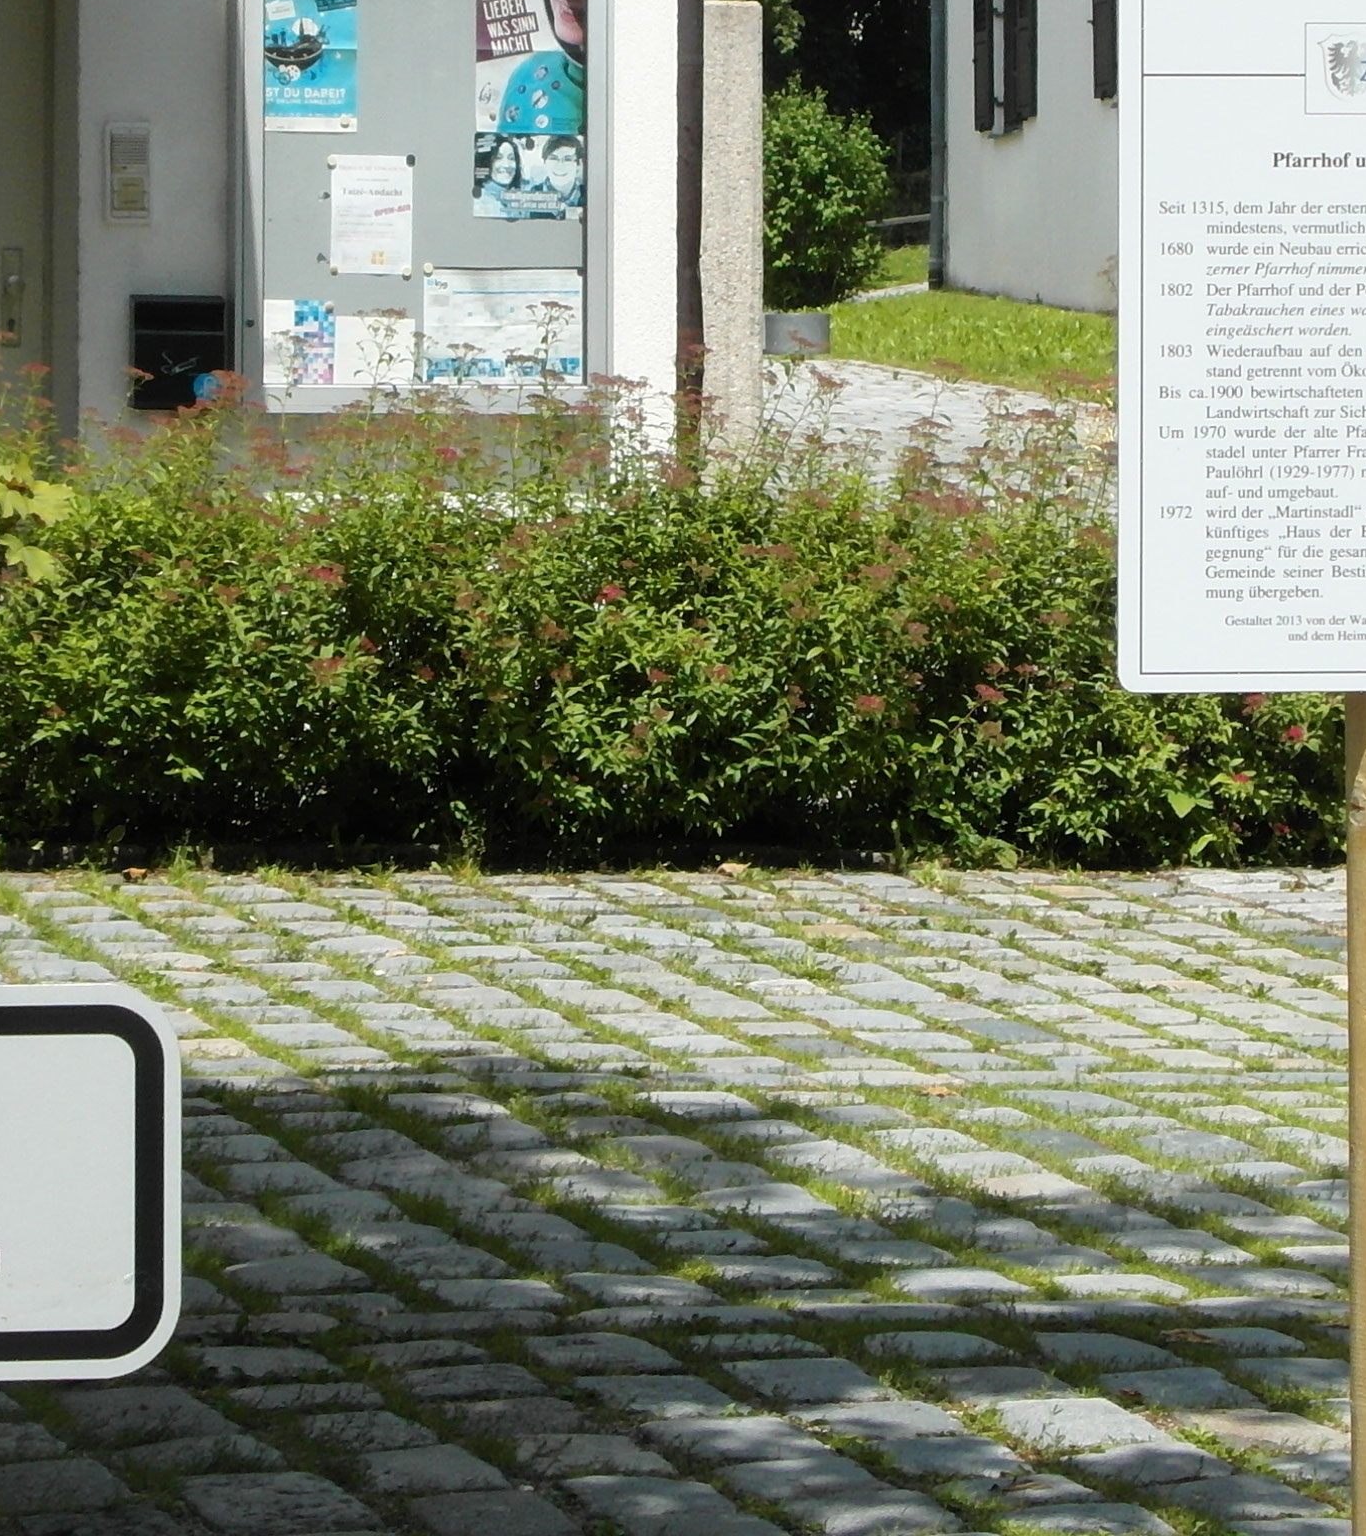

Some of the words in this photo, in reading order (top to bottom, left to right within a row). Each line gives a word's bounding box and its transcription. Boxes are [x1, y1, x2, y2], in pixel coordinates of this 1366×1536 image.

[486, 20, 511, 39] WAS
[511, 14, 537, 34] SINN
[490, 34, 531, 57] MACHT
[283, 87, 300, 99] DU
[304, 87, 347, 99] DABEI?
[1272, 151, 1352, 168] Pfarrhof
[1158, 200, 1186, 215] Seit
[1192, 200, 1229, 217] 1315,
[1233, 200, 1263, 215] dem
[1267, 200, 1297, 215] Jahr
[1300, 200, 1324, 215] der
[1206, 220, 1288, 236] mindestens,
[1292, 220, 1366, 235] vermutlich
[1160, 241, 1194, 256] 1680
[1206, 241, 1250, 256] wurde
[1252, 241, 1275, 256] ein
[1279, 241, 1332, 256] Neubau
[1205, 265, 1251, 277] zerner
[1253, 261, 1316, 280] Pfarrhof
[1160, 282, 1194, 297] 1802
[1205, 282, 1233, 297] Der
[1236, 282, 1296, 297] Pfarrhof
[1298, 282, 1325, 297] und
[1328, 282, 1353, 297] der
[1206, 302, 1305, 317] Tabakrauchen
[1309, 303, 1346, 317] eines
[1205, 322, 1294, 340] eingeäschert
[1297, 322, 1352, 337] worden.
[1160, 343, 1193, 358] 1803
[1206, 343, 1303, 358] Wiederaufbau
[1309, 343, 1333, 358] auf
[1337, 343, 1363, 358] den
[1205, 363, 1242, 378] stand
[1246, 366, 1303, 382] getrennt
[1306, 367, 1337, 378] vom
[1159, 385, 1182, 400] Bis
[1250, 384, 1364, 399] bewirtschafteten
[1205, 404, 1310, 419] Landwirtschaft
[1313, 408, 1337, 419] zur
[1158, 425, 1185, 440] Um
[1193, 425, 1227, 439] 1970
[1233, 425, 1277, 439] wurde
[1283, 425, 1307, 439] der
[1313, 424, 1339, 439] alte
[1205, 445, 1246, 459] stadel
[1251, 447, 1288, 459] unter
[1293, 444, 1341, 459] Pfarrer
[1205, 465, 1264, 479] Paulöhrl
[1269, 464, 1355, 481] (1929-1977)
[1205, 484, 1234, 499] auf-
[1237, 485, 1264, 499] und
[1267, 484, 1339, 503] umgebaut.
[1160, 505, 1193, 520] 1972
[1205, 505, 1237, 519] wird
[1241, 505, 1264, 519] der
[1267, 504, 1362, 520] „Martinstadl“
[1205, 524, 1270, 543] künftiges
[1278, 524, 1321, 540] „Haus
[1329, 524, 1353, 539] der
[1204, 545, 1272, 563] gegnung“
[1277, 544, 1298, 559] für
[1302, 544, 1325, 559] die
[1204, 564, 1276, 579] Gemeinde
[1282, 564, 1325, 579] seiner
[1205, 588, 1245, 603] mung
[1248, 584, 1324, 603] übergeben.
[1224, 615, 1273, 627] Gestaltet
[1275, 614, 1303, 626] 2013
[1305, 617, 1326, 626] von
[1328, 614, 1347, 626] der
